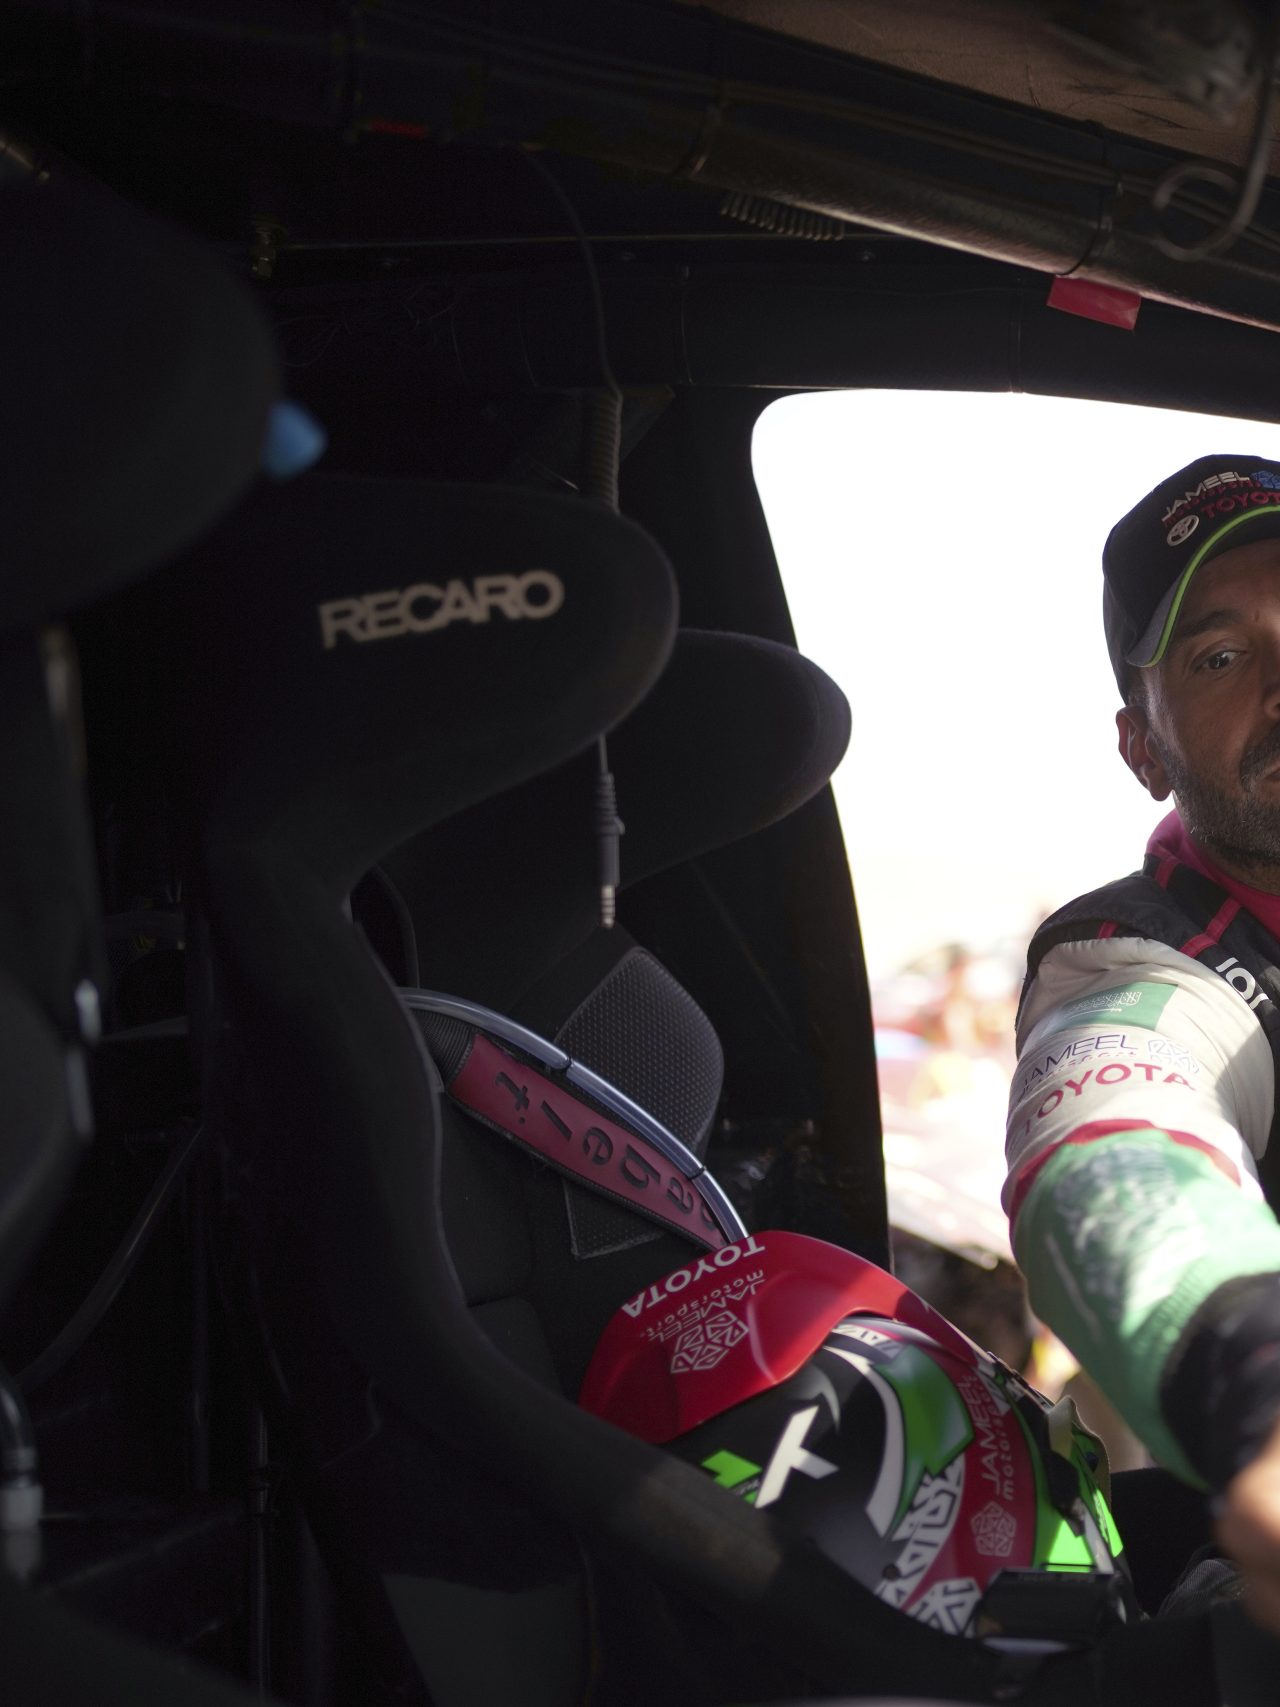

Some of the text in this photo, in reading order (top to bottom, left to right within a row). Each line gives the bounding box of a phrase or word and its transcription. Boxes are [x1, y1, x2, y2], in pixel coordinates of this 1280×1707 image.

[1161, 471, 1250, 522] JAMEEL
[319, 570, 565, 650] RECARO
[621, 1236, 766, 1319] TOYOTA
[645, 1269, 764, 1337] motorsport
[649, 1279, 766, 1343] JAMEEL
[957, 1375, 1001, 1497] JAMEEL
